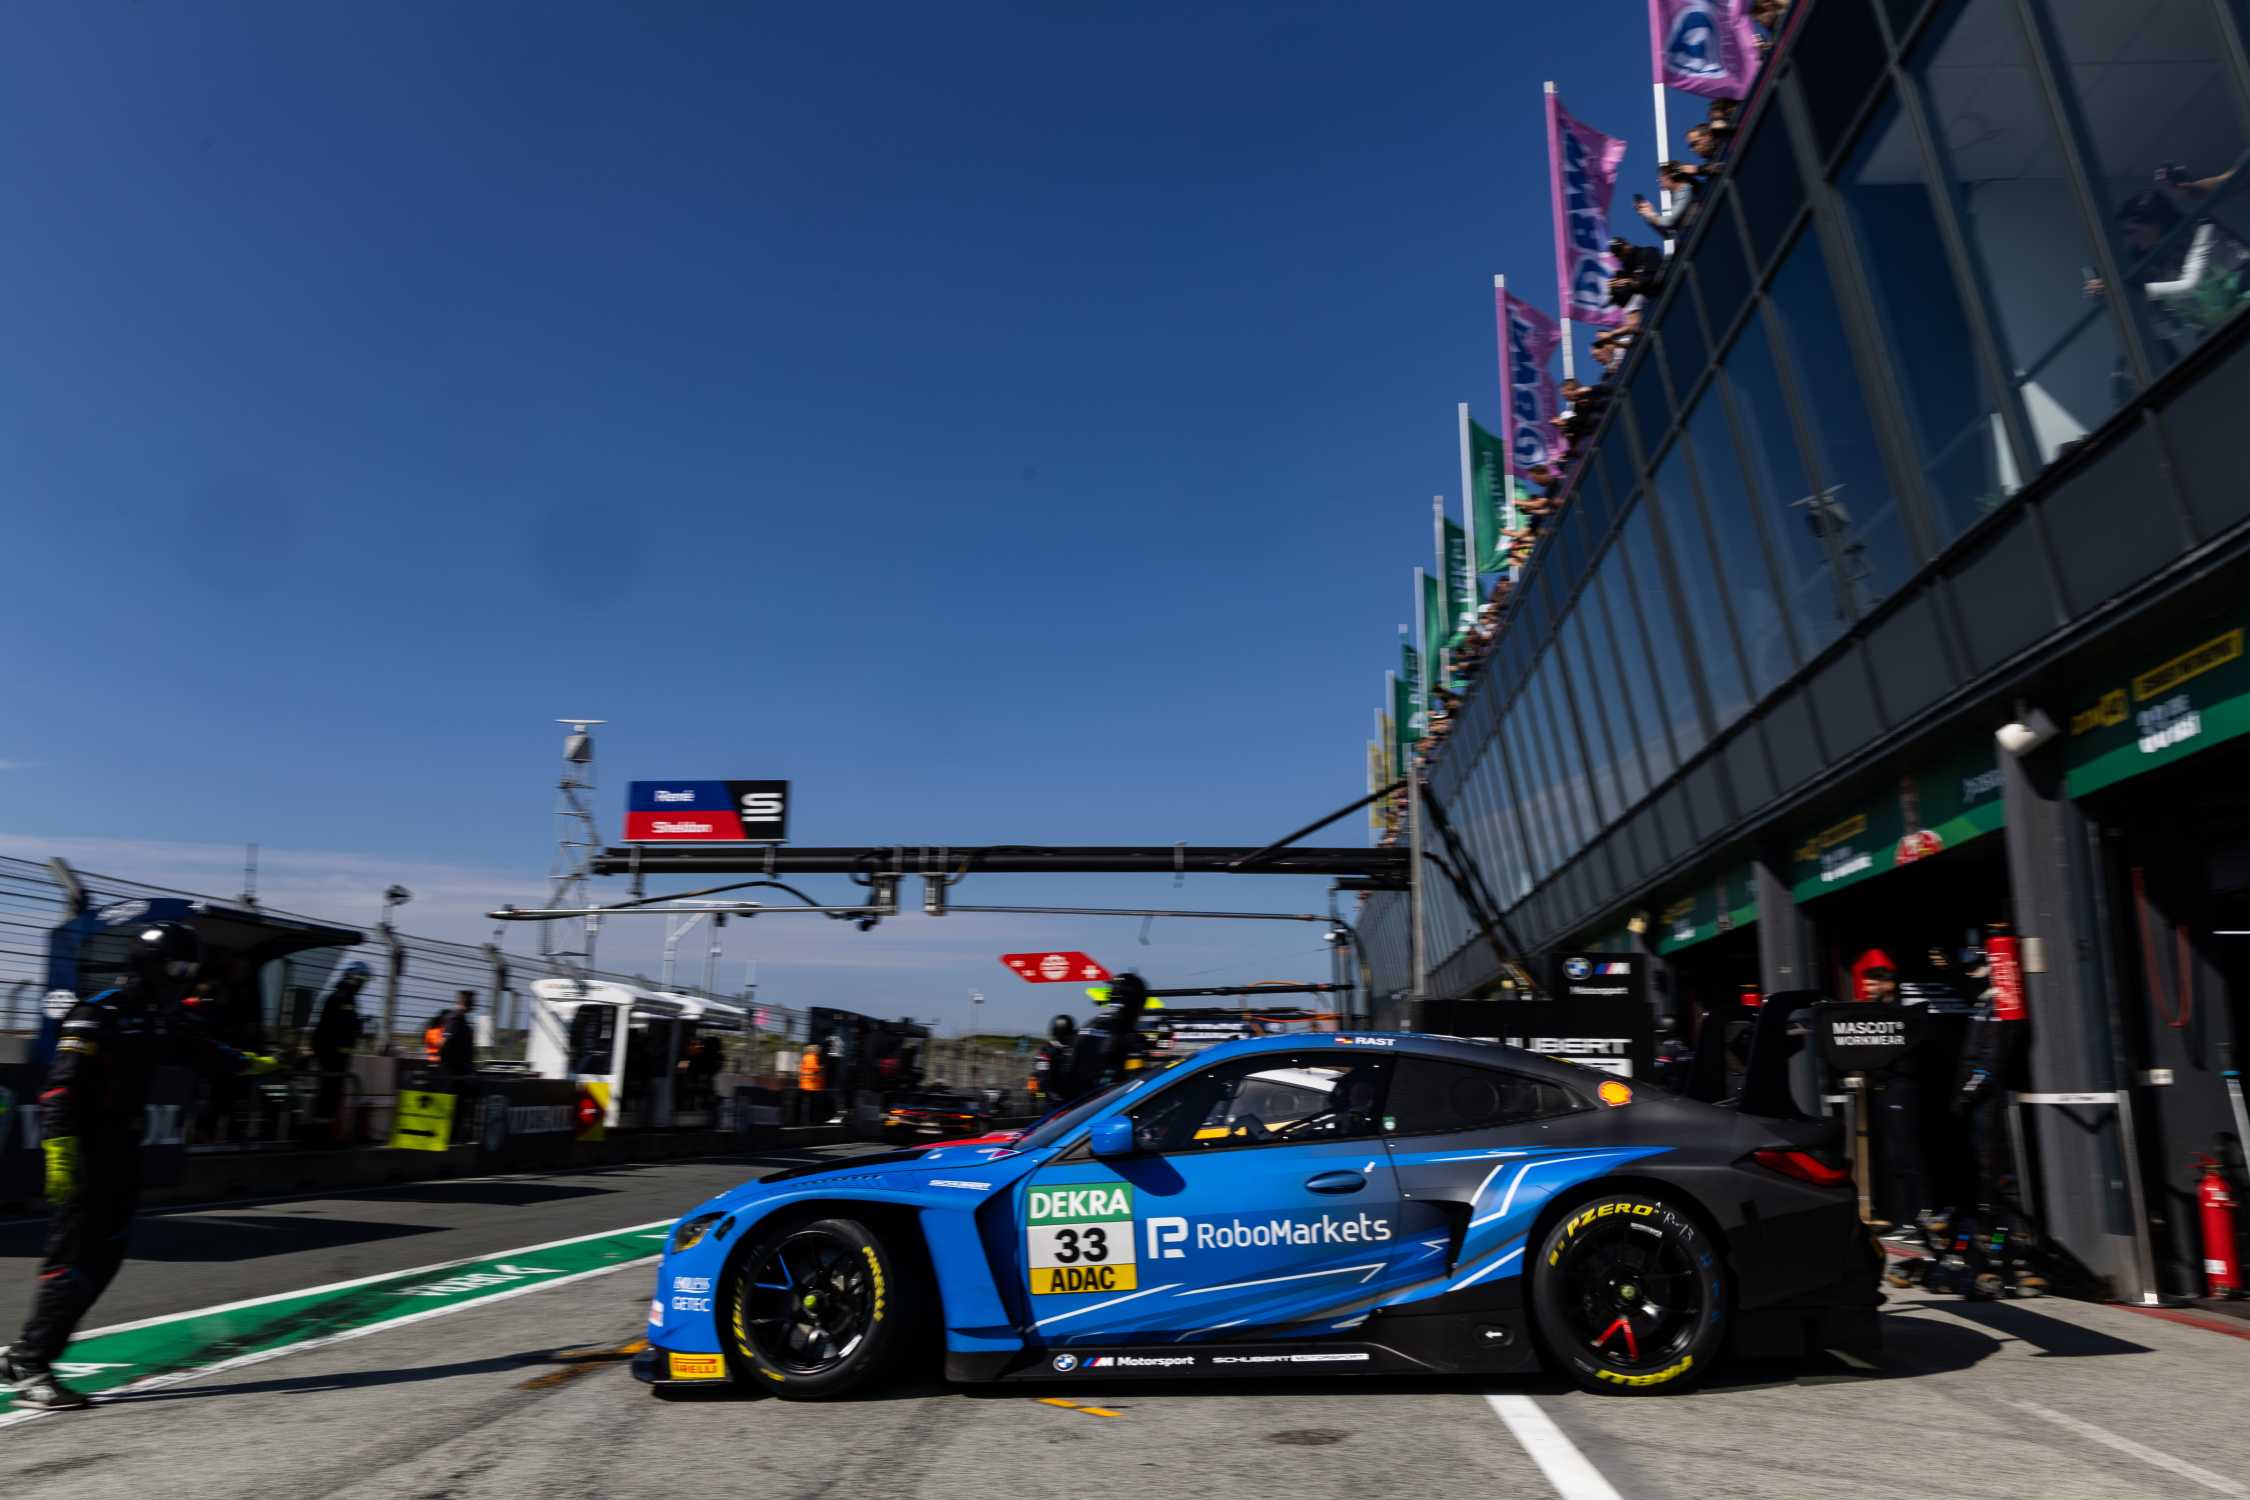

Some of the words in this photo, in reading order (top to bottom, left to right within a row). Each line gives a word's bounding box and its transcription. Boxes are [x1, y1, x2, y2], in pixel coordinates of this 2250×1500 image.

[1355, 1037, 1397, 1047] RAST
[1834, 1036, 1905, 1046] WORKWEAR
[1030, 1188, 1131, 1219] DEKRA
[1197, 1212, 1392, 1249] RoboMarkets
[1054, 1227, 1109, 1263] 33
[1051, 1266, 1115, 1292] ADAC
[672, 1296, 712, 1312] GETEC
[1117, 1356, 1195, 1368] Motorsport
